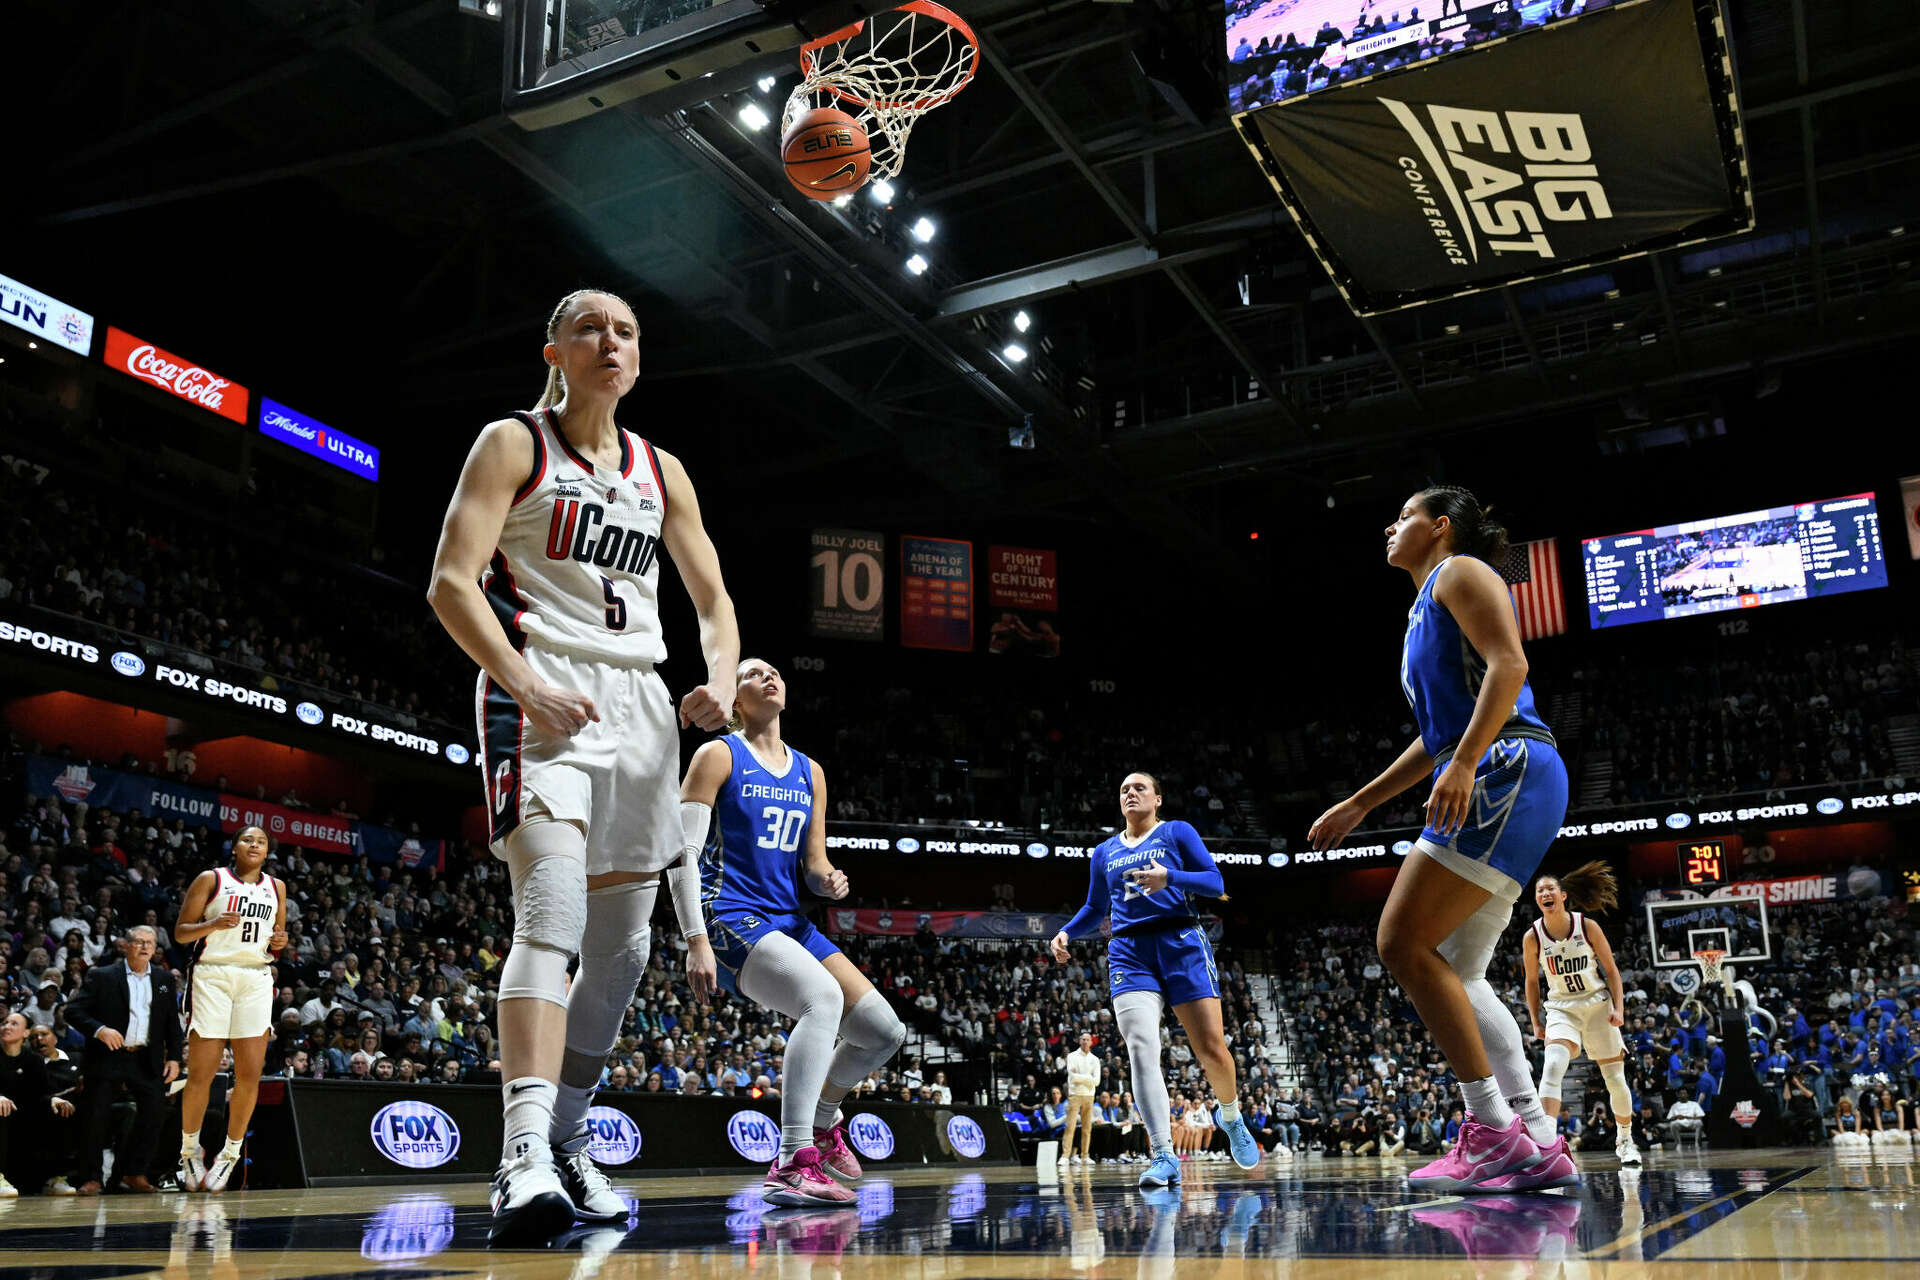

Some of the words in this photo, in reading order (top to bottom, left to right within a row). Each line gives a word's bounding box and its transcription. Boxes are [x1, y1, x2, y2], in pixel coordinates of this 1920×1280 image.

[1409, 27, 1424, 39] 22
[1505, 111, 1613, 221] BIG
[1426, 104, 1555, 258] EAST
[1399, 156, 1467, 266] CONFERENCE
[127, 345, 230, 410] Coca-Cola
[264, 412, 315, 441] Michelob
[327, 434, 375, 469] ULTRA
[556, 489, 581, 497] CHANGE
[546, 499, 657, 577] UConn
[811, 534, 846, 549] BILLY
[848, 538, 883, 552] JOEL
[910, 553, 948, 565] ARENA
[949, 556, 964, 567] OF
[1002, 551, 1043, 567] FIGHT
[811, 550, 884, 612] 10
[911, 564, 933, 575] THE
[935, 567, 963, 577] YEAR
[991, 572, 1056, 589] CENTURY
[600, 575, 627, 631] 5
[1718, 620, 1749, 636] 112
[0, 622, 99, 663] SPORTS
[792, 656, 825, 671] 109
[155, 665, 200, 691] FOX
[204, 679, 287, 714] SPORTS
[332, 713, 368, 736] FOX
[371, 724, 439, 755] SPORTS
[163, 748, 197, 775] 16
[741, 784, 812, 807] CREIGHTON
[1851, 794, 1888, 810] FOX
[1892, 791, 1920, 806] SP
[151, 791, 213, 817] FOLLOW
[219, 805, 239, 822] US
[244, 810, 265, 828] ON
[290, 820, 359, 846] @BIGEAST
[1698, 809, 1733, 824] FOX
[1736, 803, 1809, 820] SPORTS
[757, 806, 807, 852] 30
[1556, 824, 1588, 838] FOX
[1591, 818, 1658, 835] SPORTS
[826, 836, 890, 850] SPORTS
[926, 840, 957, 853] FOX
[959, 842, 1020, 855] SPORTS
[1055, 846, 1084, 858] FOX
[1690, 845, 1721, 860] 7:01
[1107, 848, 1166, 872] CREIGHTON
[1295, 850, 1324, 864] FOX
[1327, 845, 1386, 861] SPORTS
[1742, 846, 1776, 864] 20
[1687, 859, 1721, 884] 24
[1768, 877, 1838, 904] SHINE
[241, 921, 260, 944] 21
[1546, 954, 1588, 976] UConn
[1564, 973, 1586, 993] 20
[388, 1114, 442, 1142] FOX
[586, 1118, 628, 1142] FOX
[738, 1121, 771, 1142] FOX
[856, 1122, 884, 1142] FOX
[953, 1124, 977, 1141] FOX
[393, 1142, 445, 1154] SPORTS
